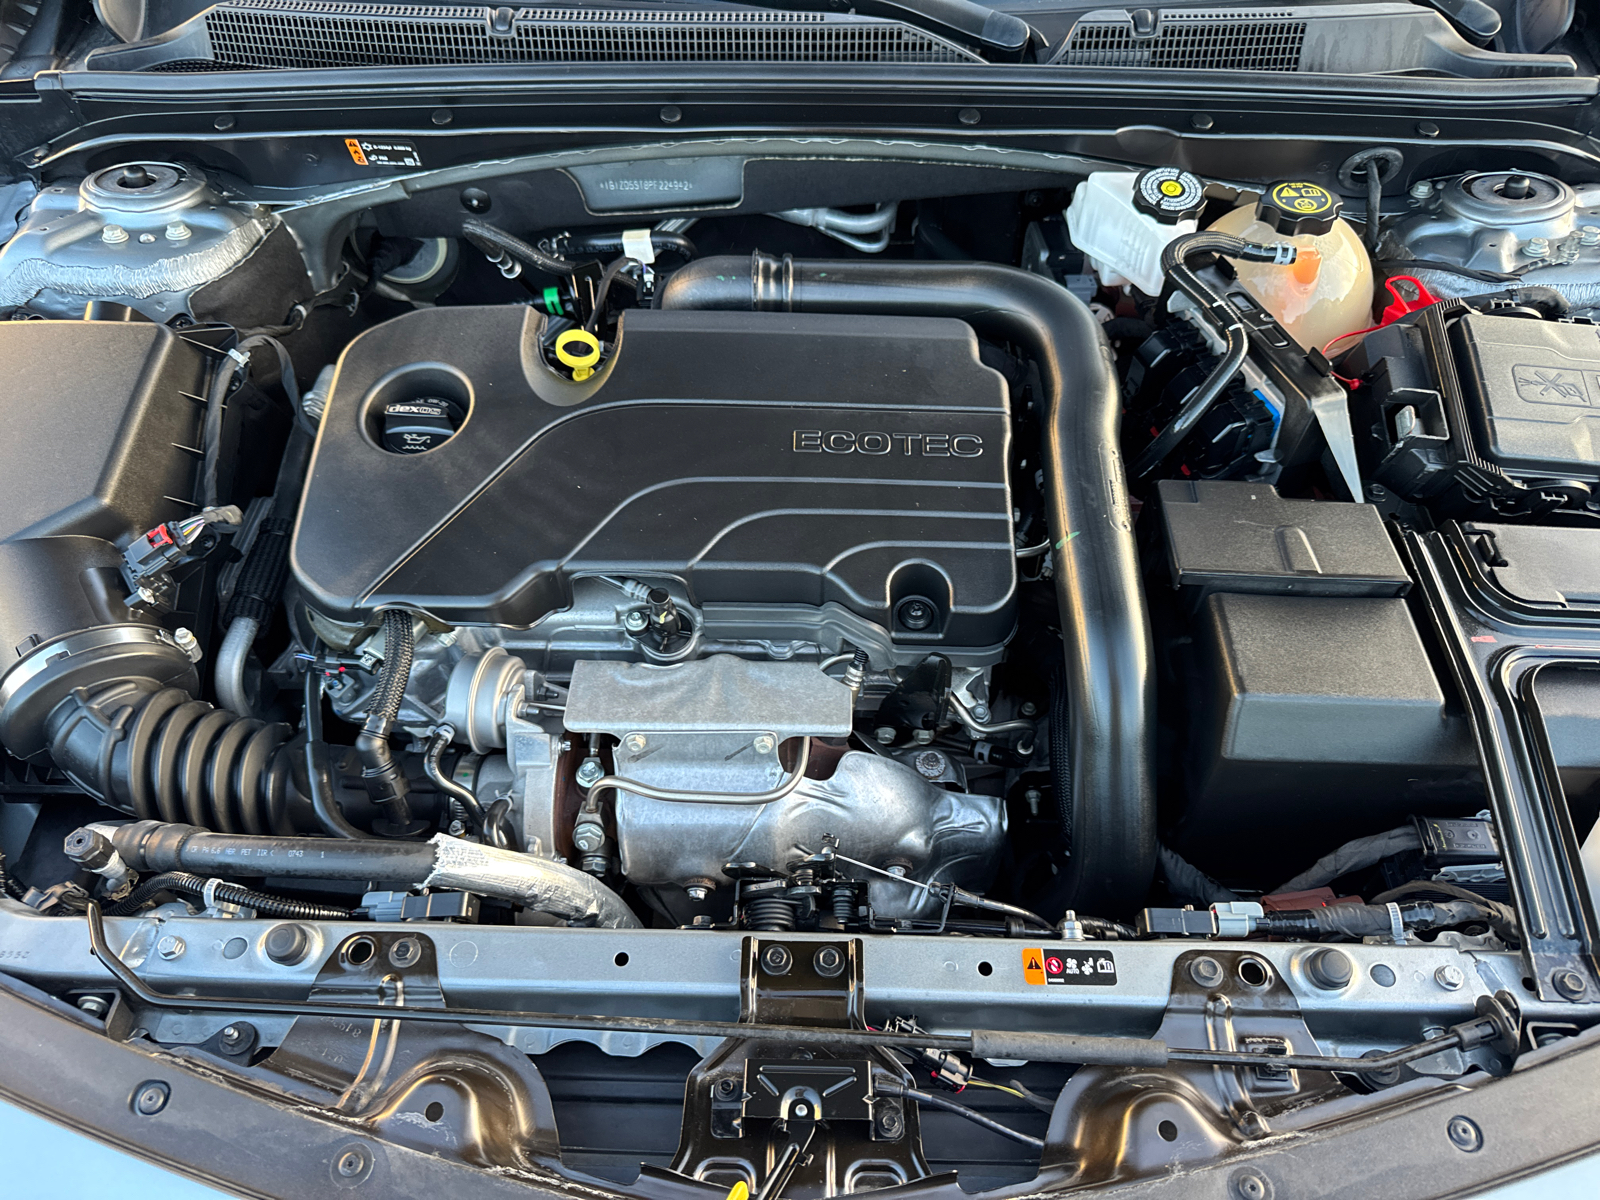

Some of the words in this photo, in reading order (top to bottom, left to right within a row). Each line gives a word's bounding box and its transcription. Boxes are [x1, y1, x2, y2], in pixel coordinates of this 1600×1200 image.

[388, 404, 442, 415] dexos
[793, 430, 983, 458] ECOTEC
[288, 850, 303, 858] 0743
